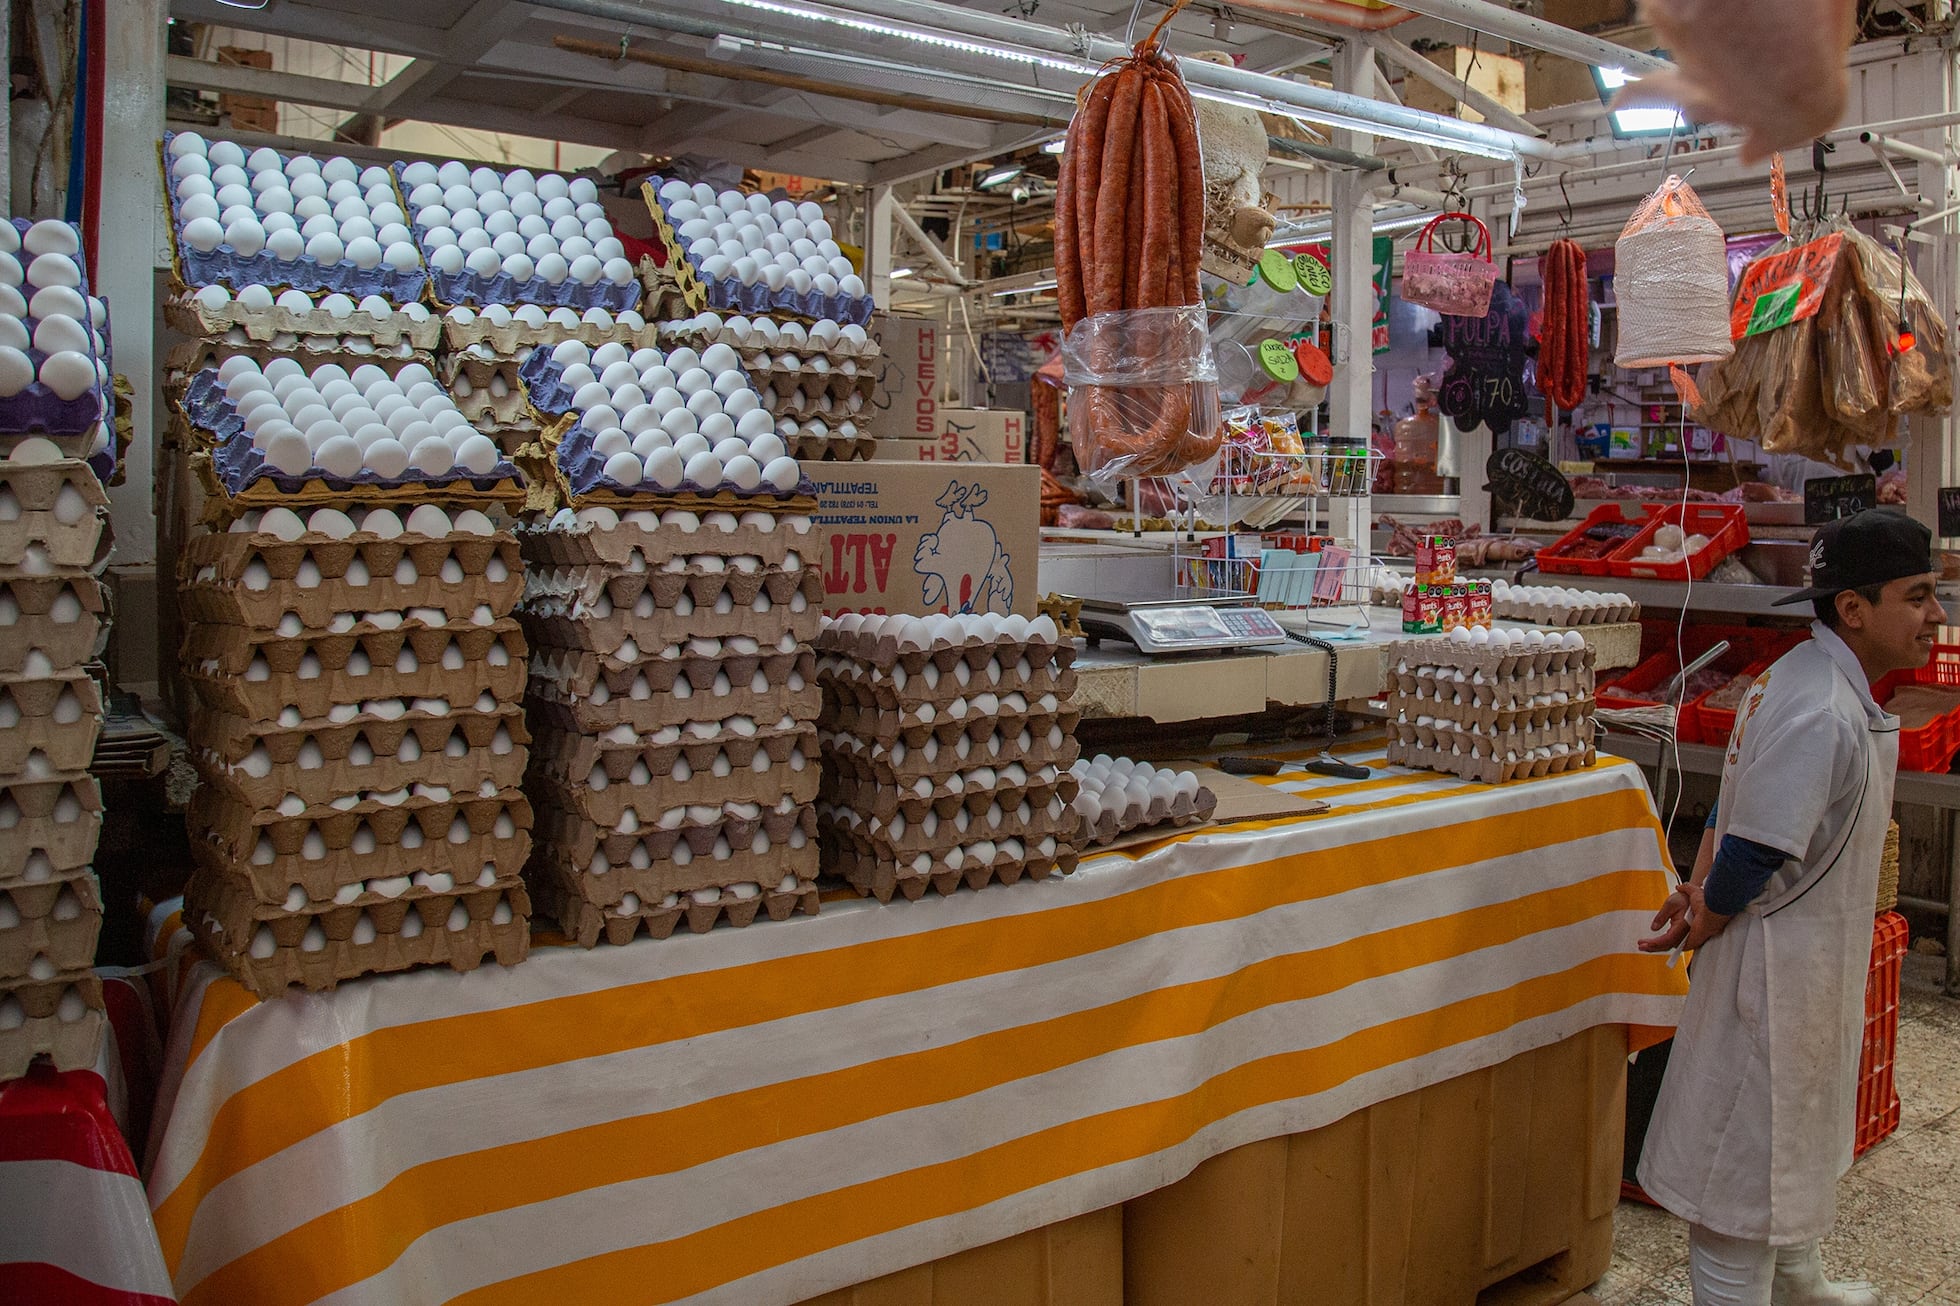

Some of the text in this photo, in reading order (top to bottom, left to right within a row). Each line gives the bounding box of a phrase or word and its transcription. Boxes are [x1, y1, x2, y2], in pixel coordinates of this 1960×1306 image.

[917, 328, 935, 433] HUEVOS
[869, 515, 903, 524] UNION
[905, 515, 919, 524] LA
